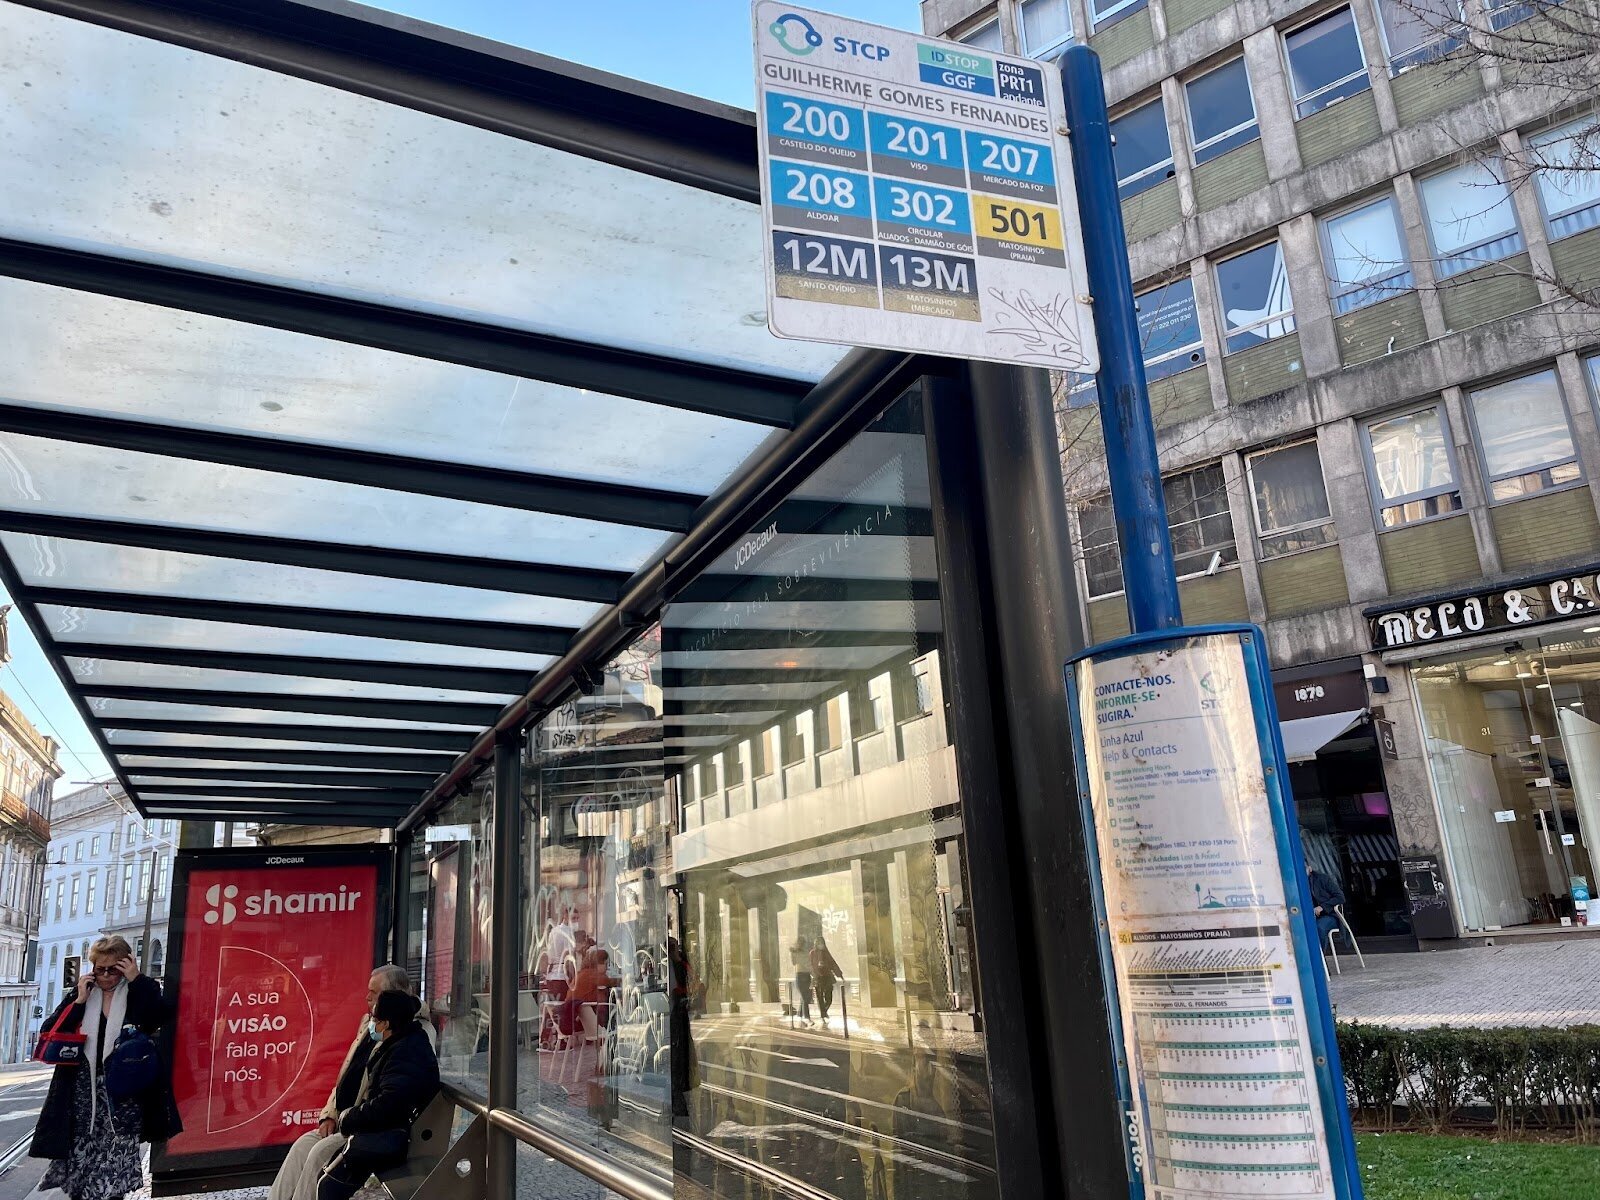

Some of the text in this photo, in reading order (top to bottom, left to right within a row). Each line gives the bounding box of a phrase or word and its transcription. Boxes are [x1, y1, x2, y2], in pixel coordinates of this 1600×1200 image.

[833, 36, 890, 62] STCP
[999, 63, 1024, 76] zona
[942, 71, 976, 90] GGF
[1000, 73, 1034, 94] PRT1
[764, 63, 1049, 133] GUILHERME GOMES FERNANDES
[1003, 92, 1043, 107] andante
[782, 101, 850, 142] 200
[779, 138, 856, 159] CASTELO DO QUEIJO
[886, 121, 948, 161] 201
[910, 161, 928, 172] VISO
[981, 139, 1039, 176] 207
[786, 169, 856, 209] 208
[983, 175, 1045, 192] MERCADO DA FOZ
[890, 186, 957, 226] 302
[806, 211, 840, 223] ALDOAR
[990, 203, 1047, 240] 501
[878, 231, 910, 243] ALIADOS
[914, 235, 945, 249] DAMIÃO
[946, 241, 956, 250] DE
[907, 226, 944, 239] CIRCULAR
[998, 240, 1045, 256] MATOSINHOS
[1010, 251, 1036, 263] (PRAIA)
[783, 238, 868, 280] 12M
[889, 254, 970, 294] 13M
[799, 280, 826, 291] SANTO
[906, 294, 958, 308] MATOSINHOS
[734, 520, 778, 571] JCDecaux
[777, 503, 892, 596] SOBREVIVÊNCIA
[1378, 596, 1485, 646] MELO
[1503, 589, 1533, 624] &
[1094, 674, 1176, 697] CONTACTE-NOS.
[1294, 685, 1325, 702] 1878
[1096, 708, 1134, 725] SUGIRA.
[1101, 730, 1144, 748] Linha Azul
[1102, 743, 1178, 764] Help & Contacts
[265, 855, 305, 865] JCDecaux
[243, 884, 362, 916] shamir
[1160, 931, 1203, 941] MATOSINHOS
[1204, 929, 1231, 940] (PRAIA)
[229, 990, 280, 1007] A sua
[227, 1013, 287, 1034] VISÃO
[225, 1040, 296, 1060] fala por
[224, 1065, 262, 1083] nós.
